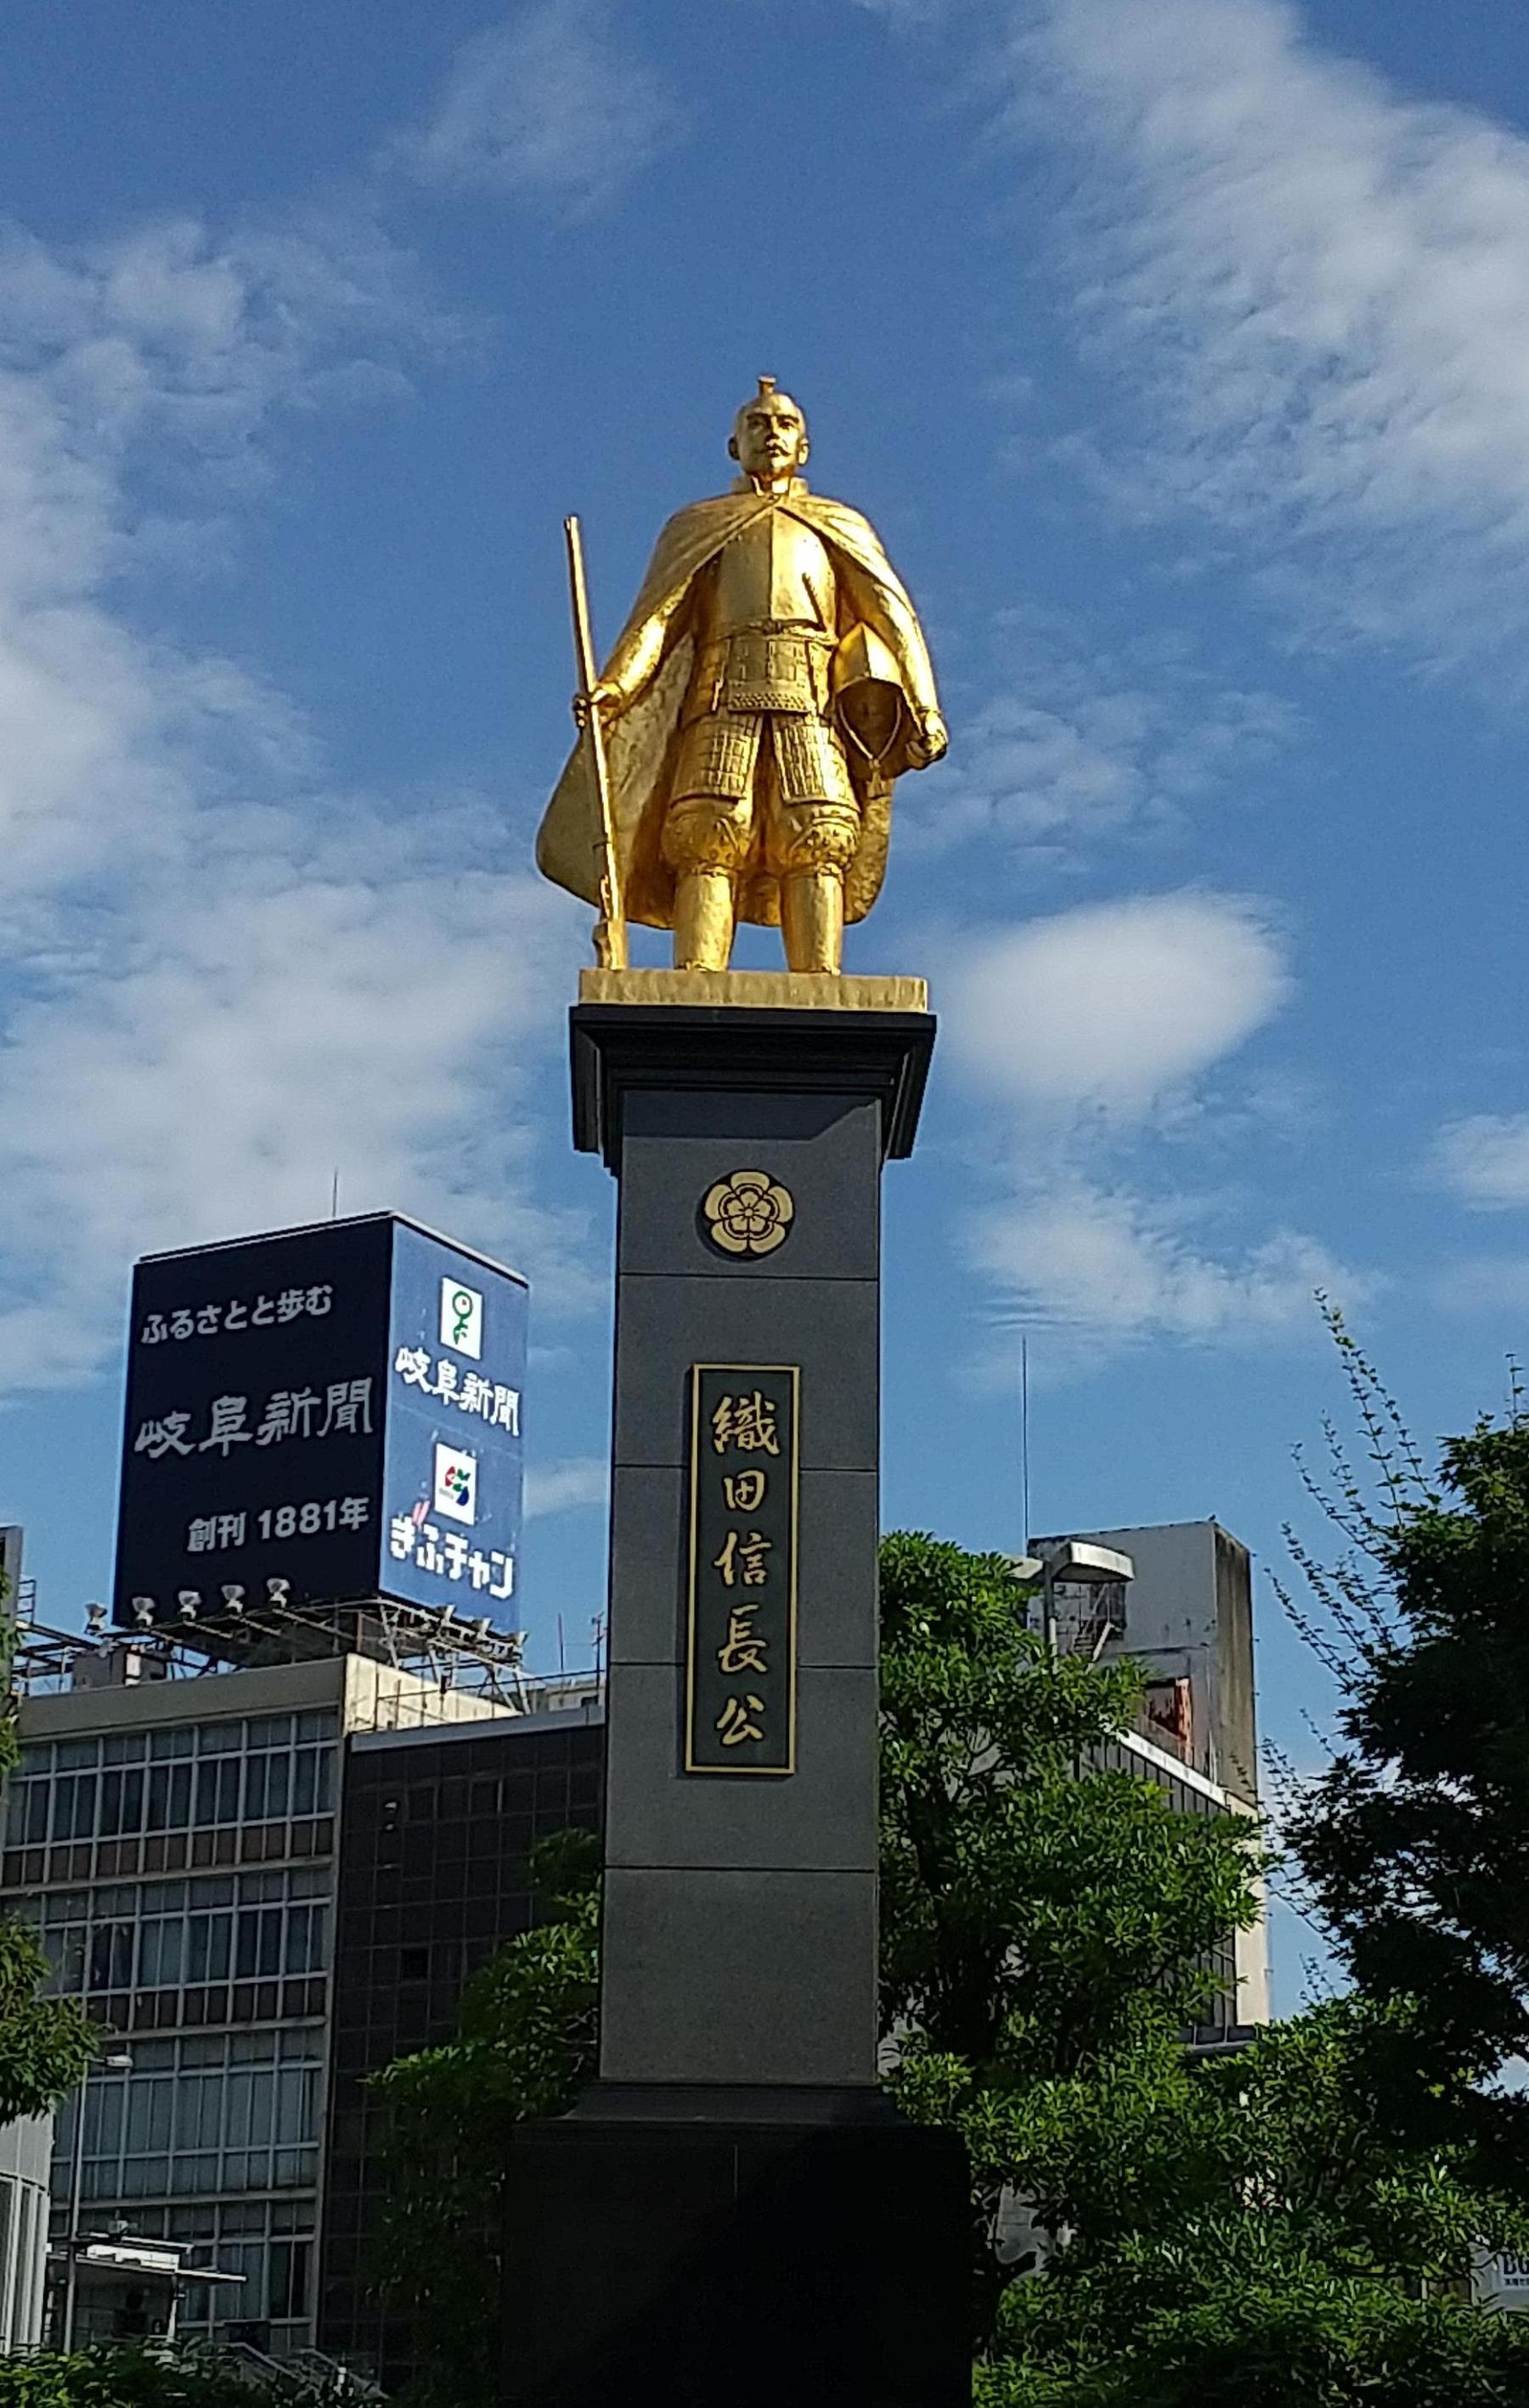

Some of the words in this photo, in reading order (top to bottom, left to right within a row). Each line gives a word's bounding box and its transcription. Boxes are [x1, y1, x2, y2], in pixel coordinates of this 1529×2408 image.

[142, 1286, 332, 1343] ふるさとと歩む
[134, 1377, 374, 1458] 岐阜新聞
[395, 1347, 520, 1437] 岐阜新聞
[390, 1501, 514, 1599] ぎふチャン
[712, 1391, 781, 1746] 織田信長公
